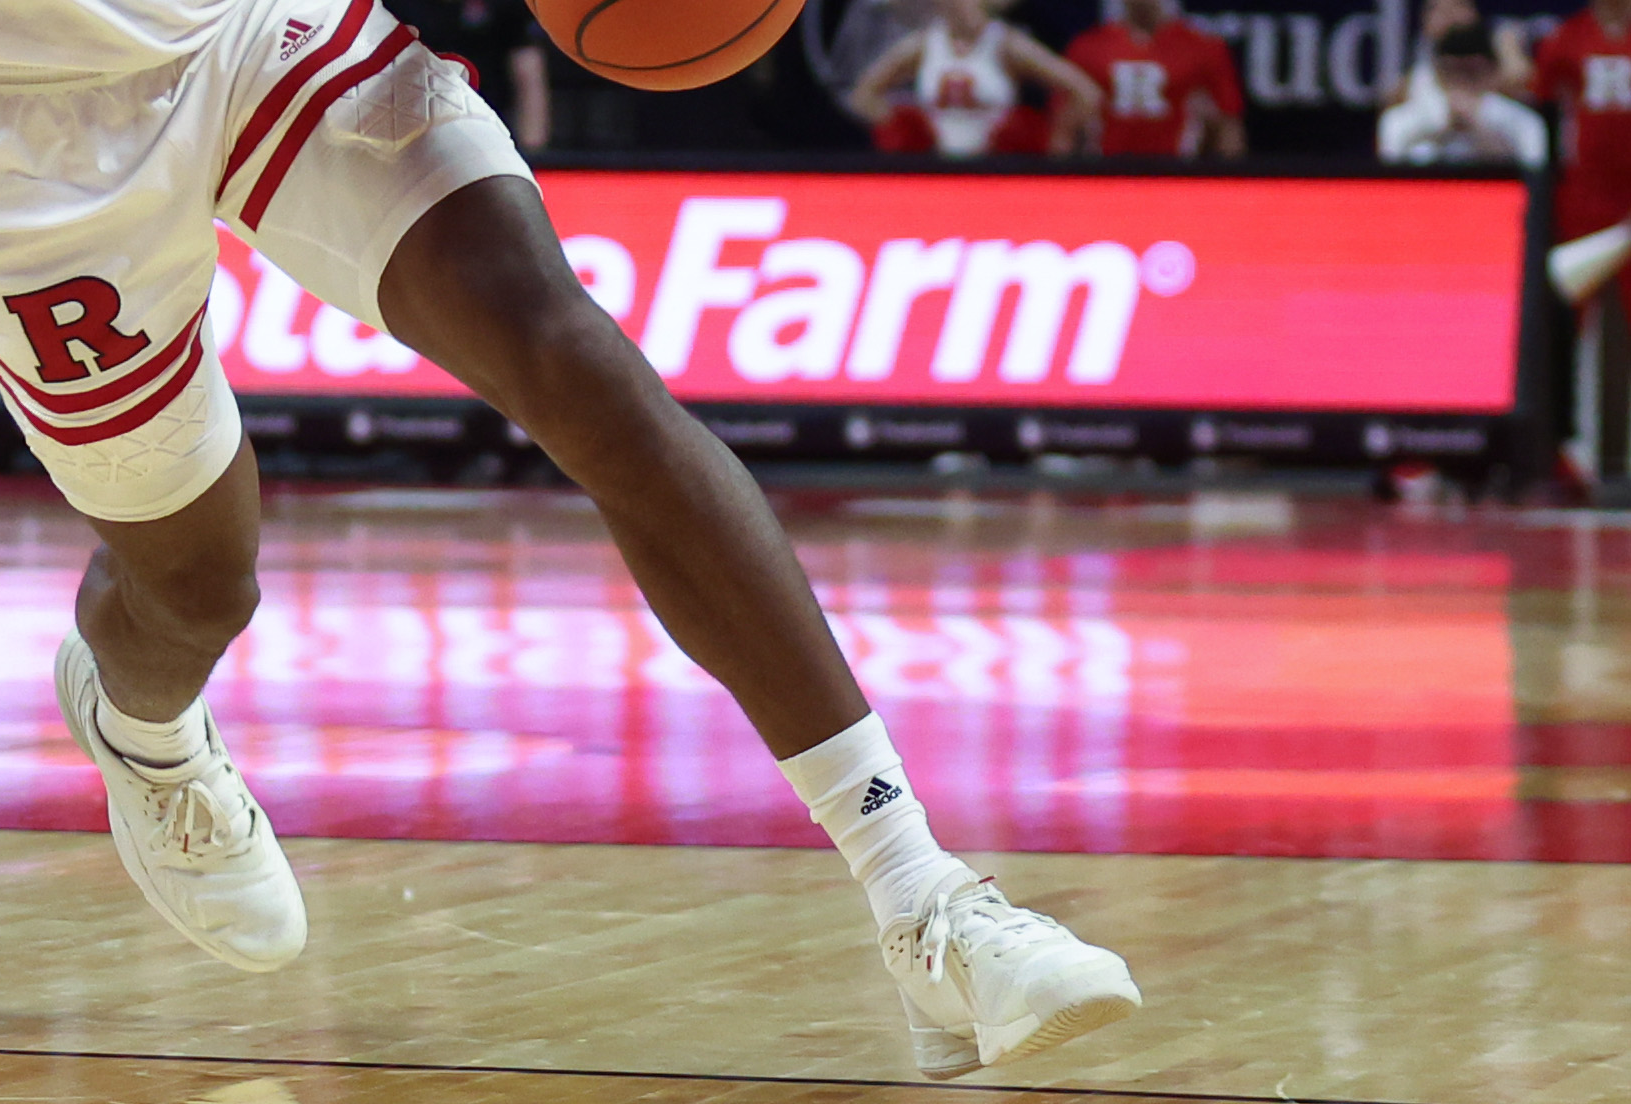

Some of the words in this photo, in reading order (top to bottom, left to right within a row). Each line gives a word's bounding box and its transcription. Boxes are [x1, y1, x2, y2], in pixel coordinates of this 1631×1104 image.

[279, 23, 324, 61] adidas
[2, 275, 152, 384] R
[860, 785, 903, 815] adidas
